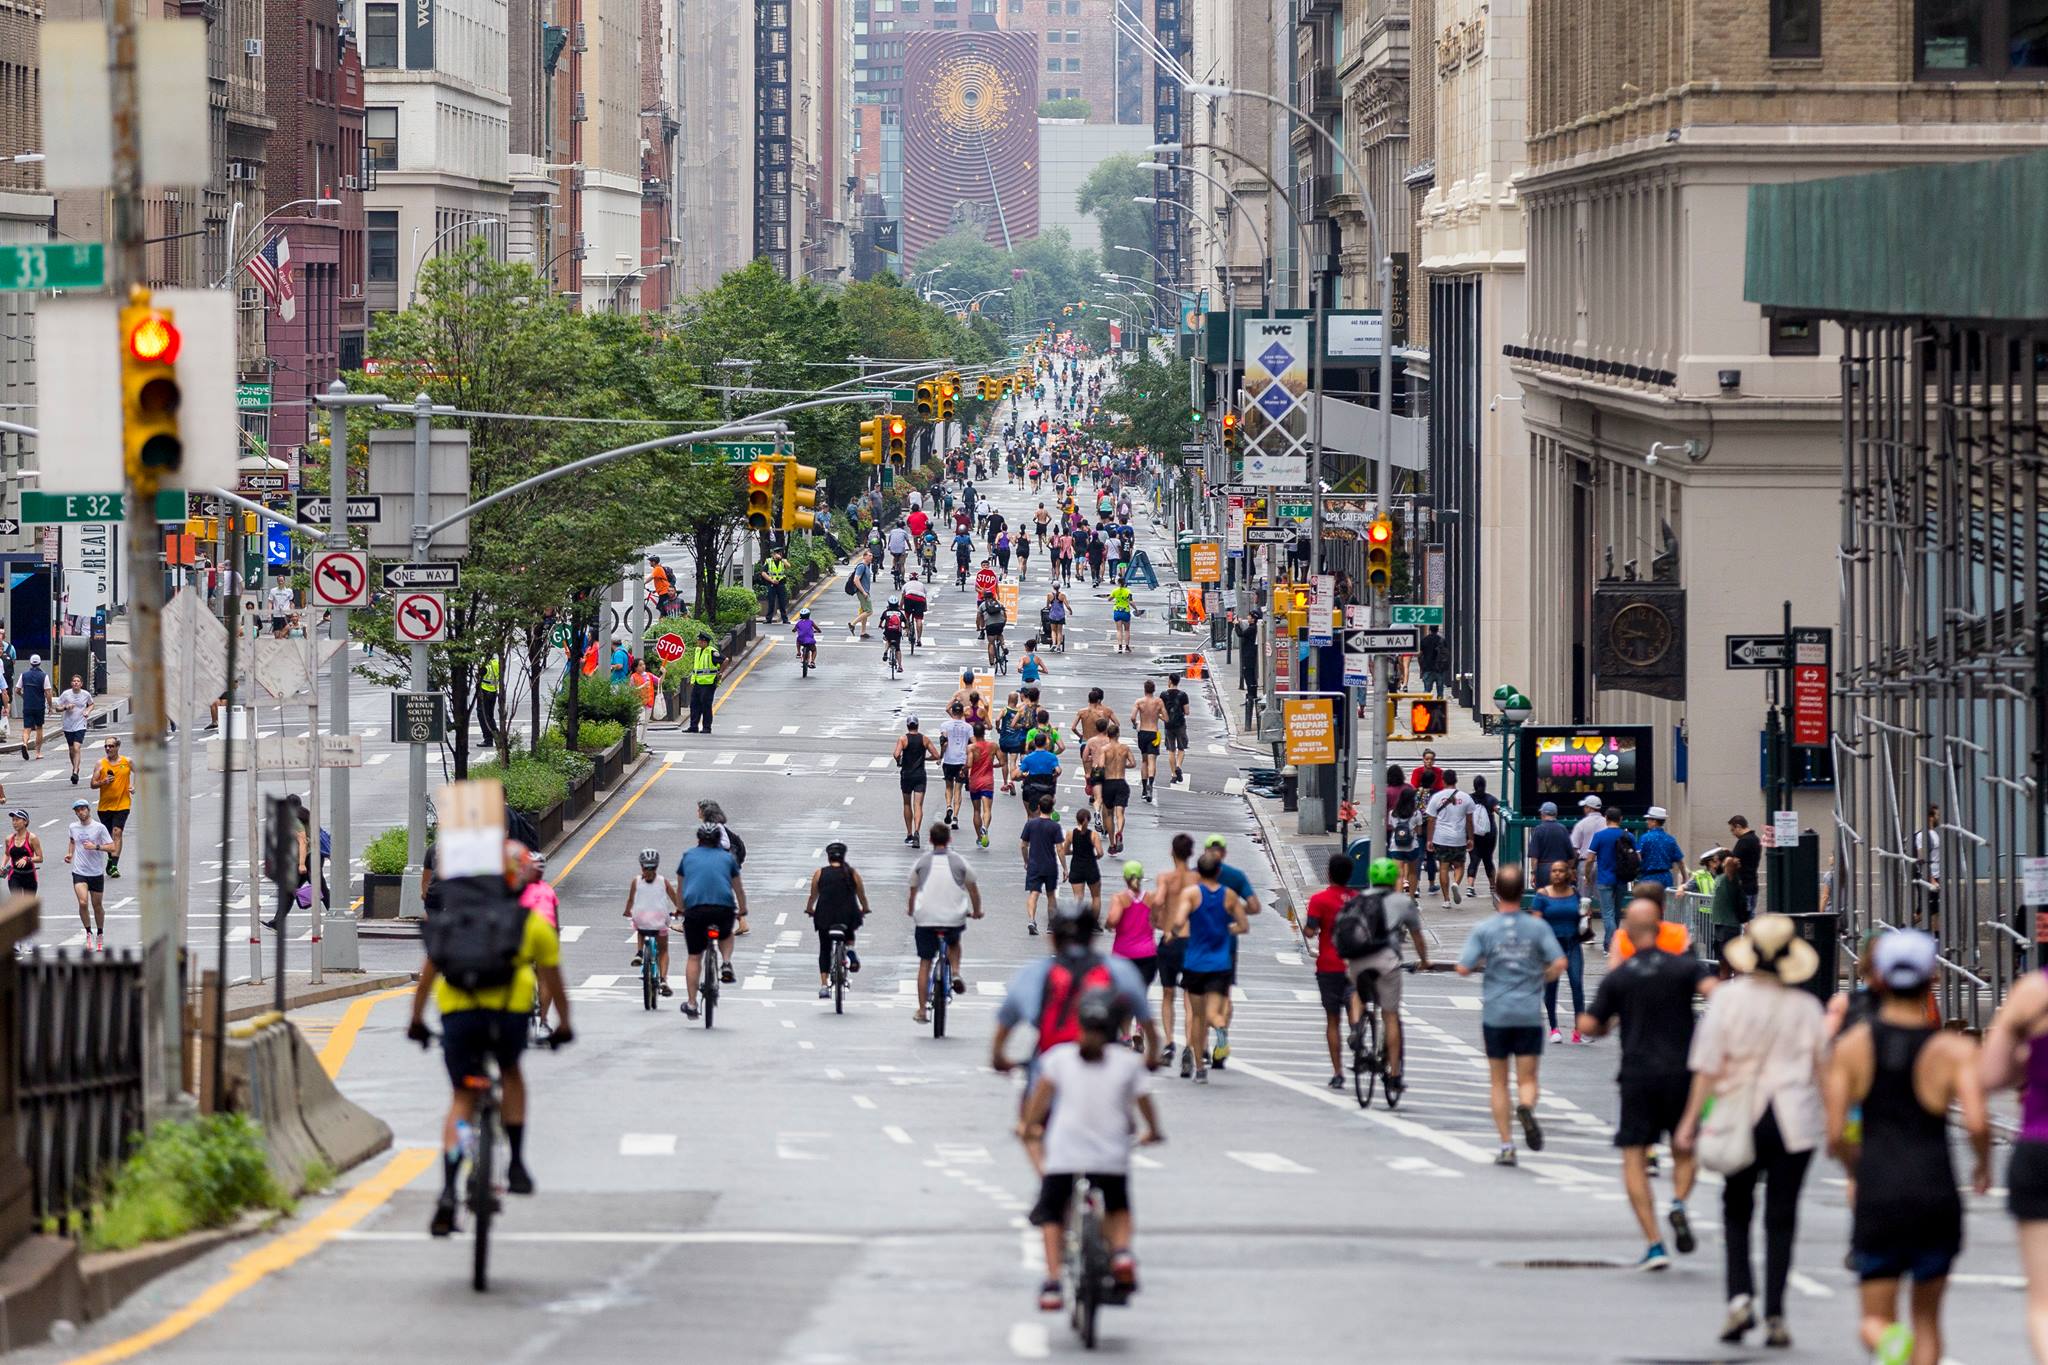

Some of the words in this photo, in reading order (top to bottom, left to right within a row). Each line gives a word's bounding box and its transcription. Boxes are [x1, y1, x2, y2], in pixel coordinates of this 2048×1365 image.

[880, 225, 892, 235] W
[16, 247, 48, 288] 33
[1262, 325, 1292, 335] NYC
[733, 447, 744, 460] 31
[750, 447, 762, 460] St
[67, 496, 77, 517] E
[86, 495, 111, 517] 32
[309, 505, 331, 516] ONE
[347, 505, 370, 515] WAY
[1281, 506, 1287, 516] E
[1290, 506, 1299, 516] 31
[1325, 512, 1341, 522] CPK
[1341, 512, 1374, 522] CATERING
[1250, 531, 1266, 539] ONE
[1274, 531, 1290, 539] WAY
[394, 571, 416, 581] ONE
[426, 570, 449, 580] WAY
[976, 573, 996, 584] STOP
[1395, 608, 1402, 622] E
[1408, 609, 1425, 623] 32
[552, 627, 572, 643] GO
[657, 638, 684, 656] STOP
[1355, 636, 1376, 647] ONE
[1386, 636, 1409, 646] WAY
[1743, 646, 1766, 657] ONE
[1291, 713, 1327, 721] CAUTION
[1290, 721, 1329, 729] PREPARE
[1593, 753, 1619, 772] $2
[1552, 763, 1592, 777] RUN
